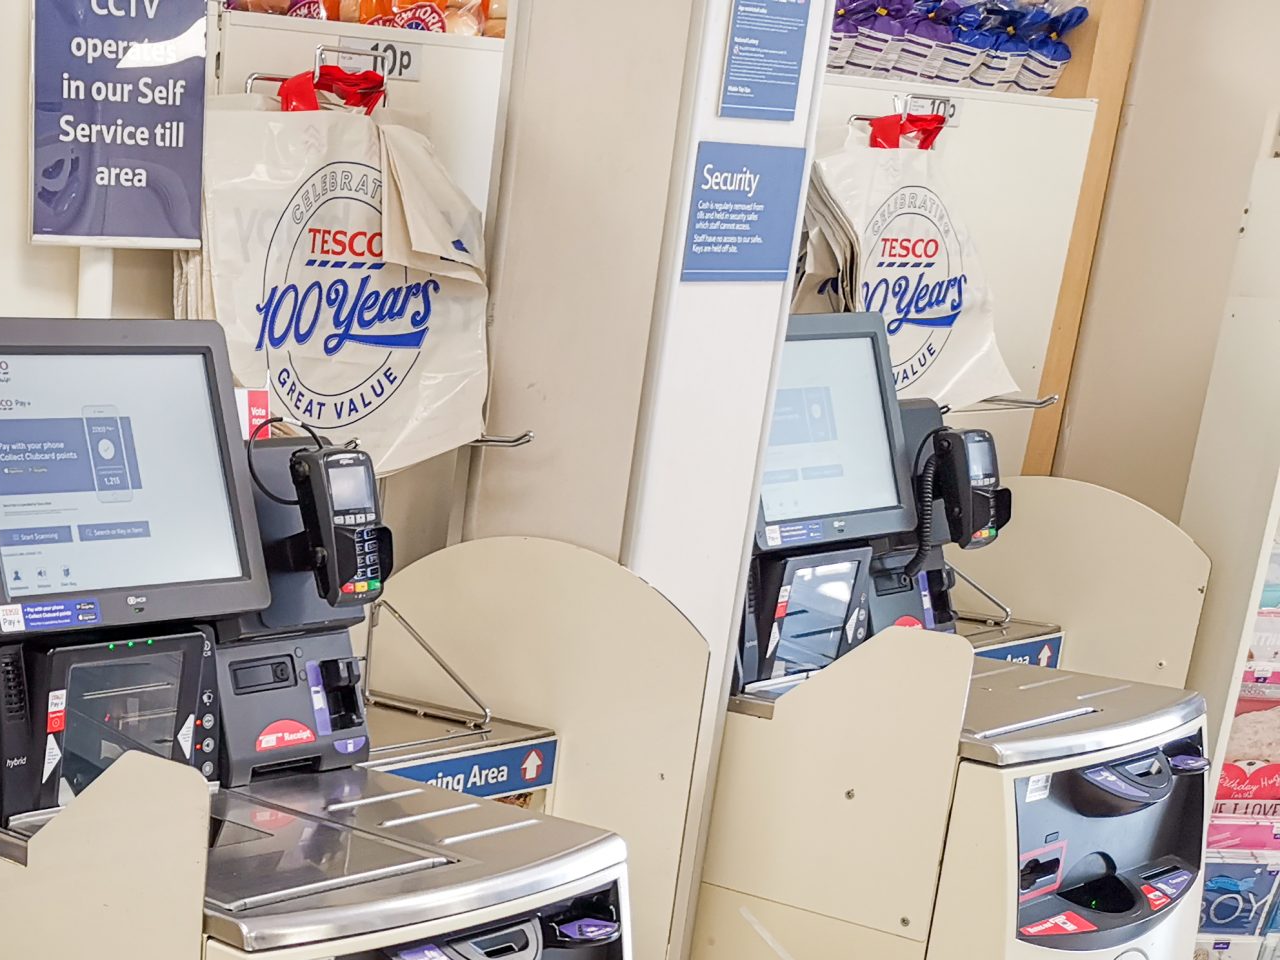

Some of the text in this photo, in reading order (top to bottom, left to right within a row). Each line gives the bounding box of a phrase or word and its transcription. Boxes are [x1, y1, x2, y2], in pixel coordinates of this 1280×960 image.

[371, 42, 413, 76] 10p
[62, 73, 186, 106] in our Self
[59, 115, 185, 148] Service till
[95, 166, 147, 187] area
[701, 163, 760, 197] Security
[291, 169, 382, 225] CELEBRAT
[308, 228, 383, 257] TESCO
[881, 238, 939, 259] TESCO
[256, 274, 440, 356] 100 Years
[887, 272, 967, 336] Years
[278, 366, 398, 420] GREAT VALUE
[251, 406, 267, 417] Vote
[284, 729, 311, 741] Receipt
[6, 756, 27, 768] hybrid
[467, 765, 508, 788] Area
